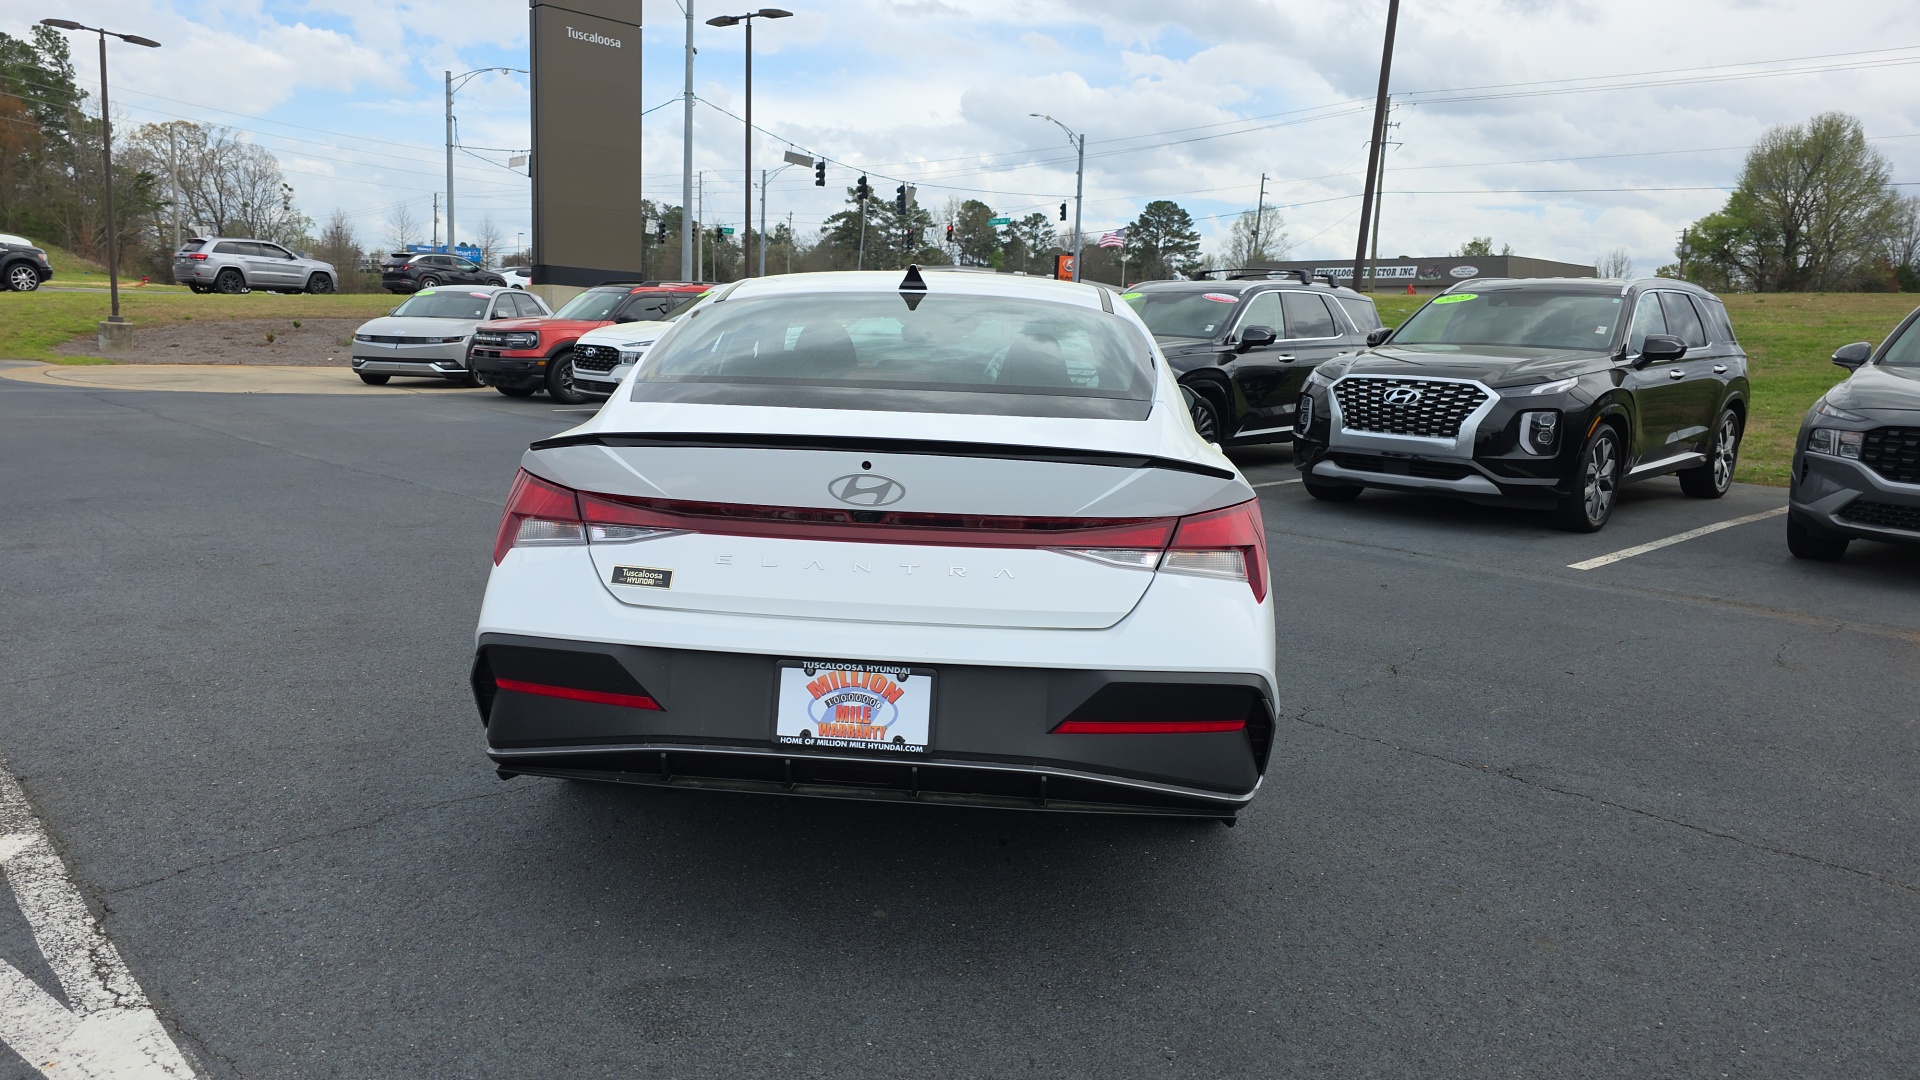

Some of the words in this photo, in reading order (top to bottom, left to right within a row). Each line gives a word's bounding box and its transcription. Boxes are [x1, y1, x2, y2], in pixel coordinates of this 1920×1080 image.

[566, 26, 621, 48] Tuscaloosa
[1316, 268, 1356, 277] TUSCALOOS
[1363, 268, 1396, 277] TCTOR
[1399, 268, 1415, 276] INC.
[622, 568, 663, 580] Tuscaloosa
[715, 553, 1016, 580] ELANTRA
[626, 576, 655, 585] HYUNDAI
[802, 661, 864, 672] TUSCALOOSA
[866, 664, 911, 675] HYUNDAI
[805, 670, 905, 705] MILLION
[835, 704, 872, 725] MILE
[817, 722, 888, 741] WARRANTY
[780, 737, 803, 745] HOME
[816, 739, 848, 748] MILLION
[849, 741, 866, 749] MILE
[867, 743, 924, 753] HYUNDAI.COM
